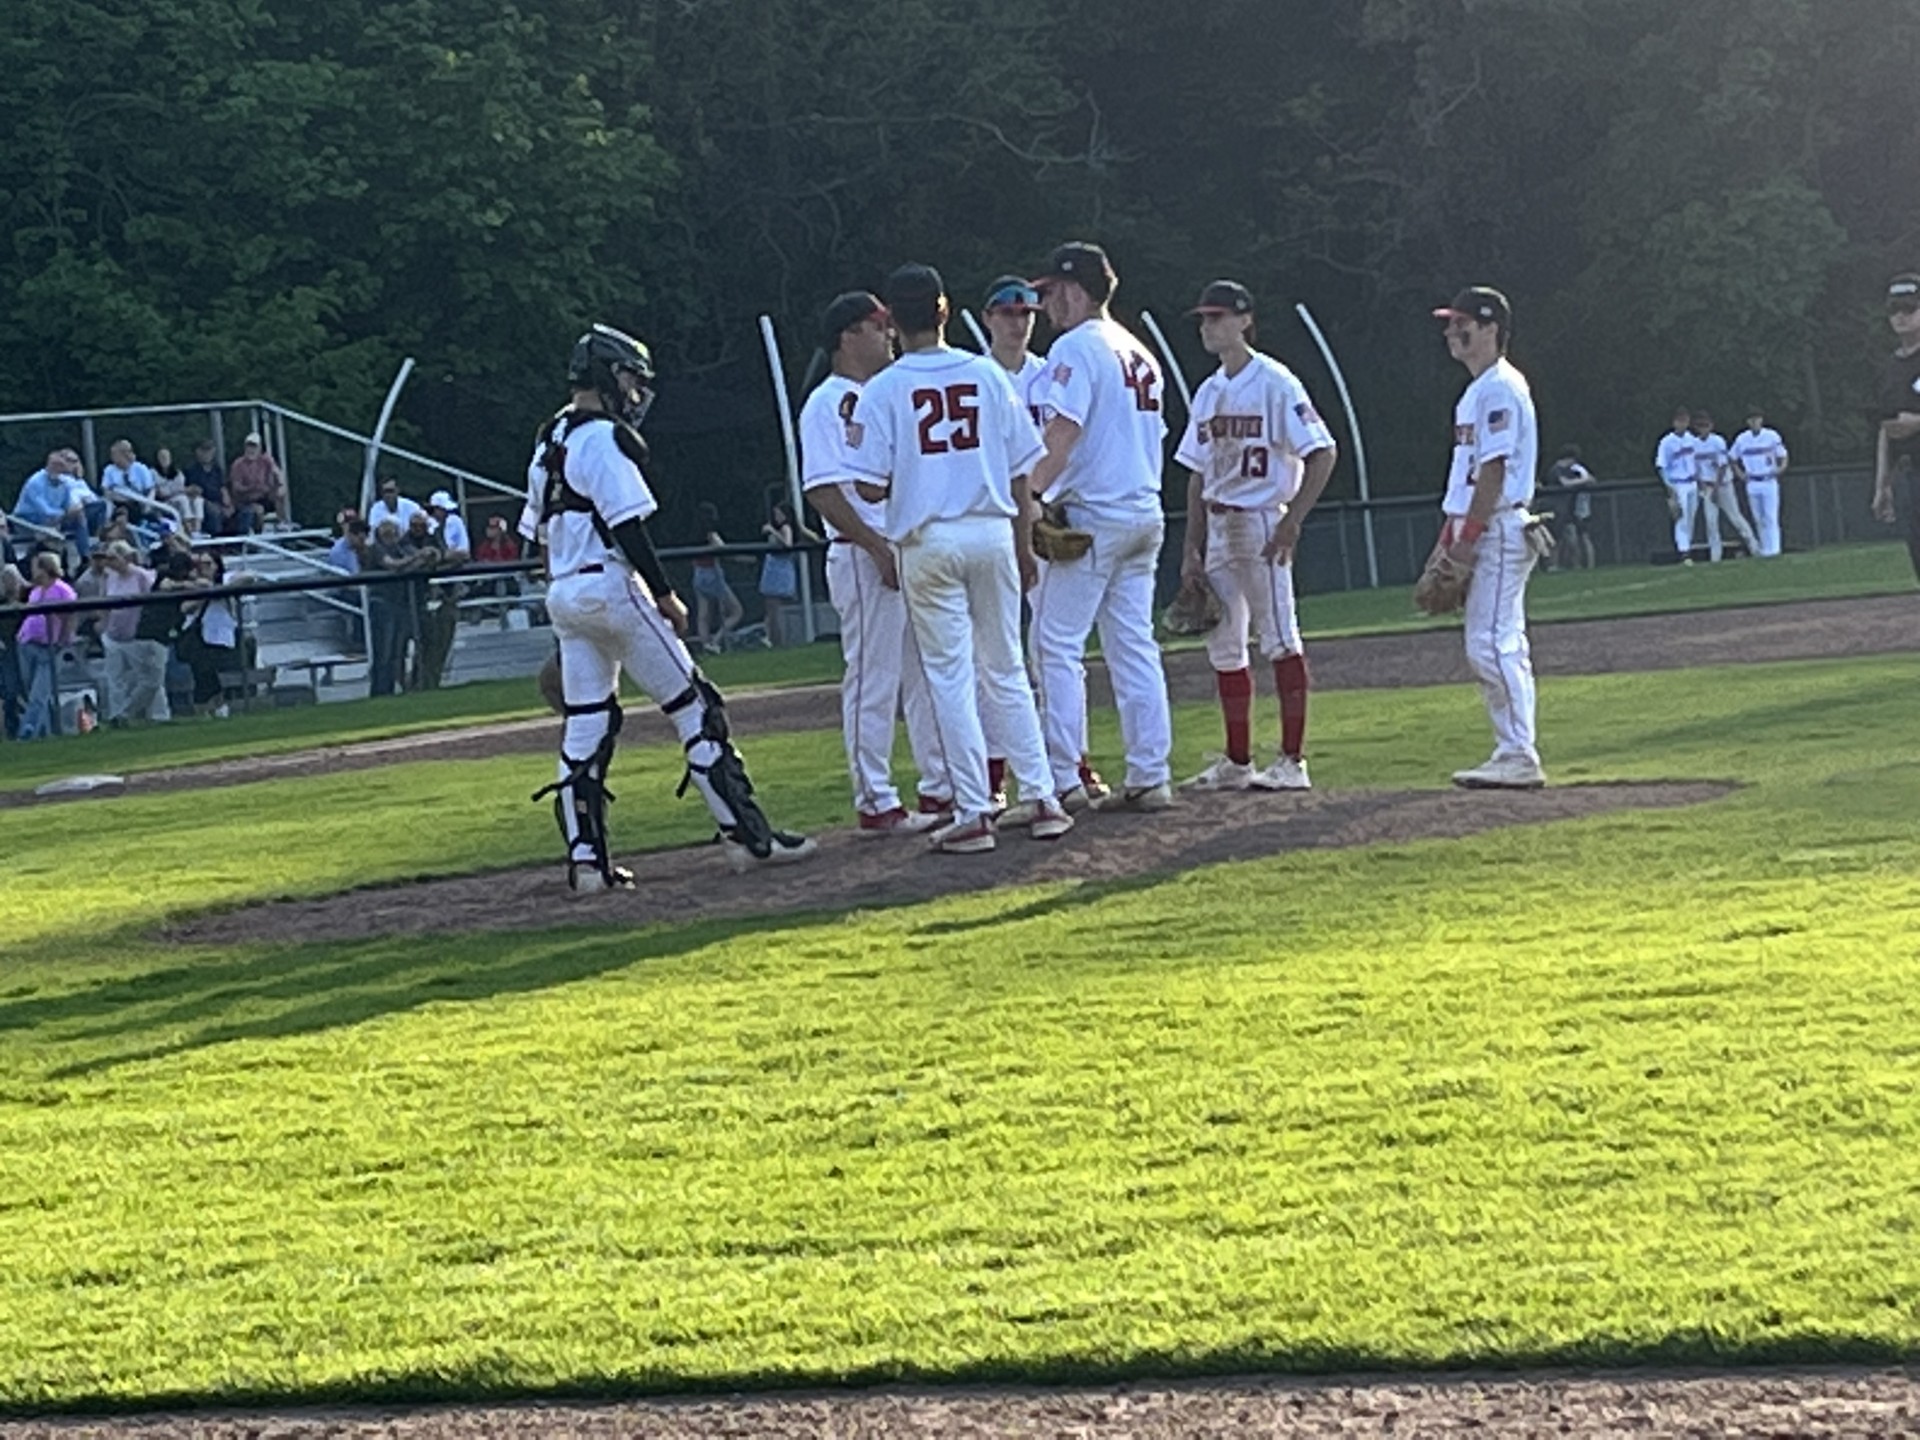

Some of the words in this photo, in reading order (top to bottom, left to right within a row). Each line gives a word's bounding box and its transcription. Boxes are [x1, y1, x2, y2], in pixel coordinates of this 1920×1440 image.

[1114, 349, 1160, 412] 42
[911, 384, 980, 455] 25
[1241, 446, 1269, 477] 13
